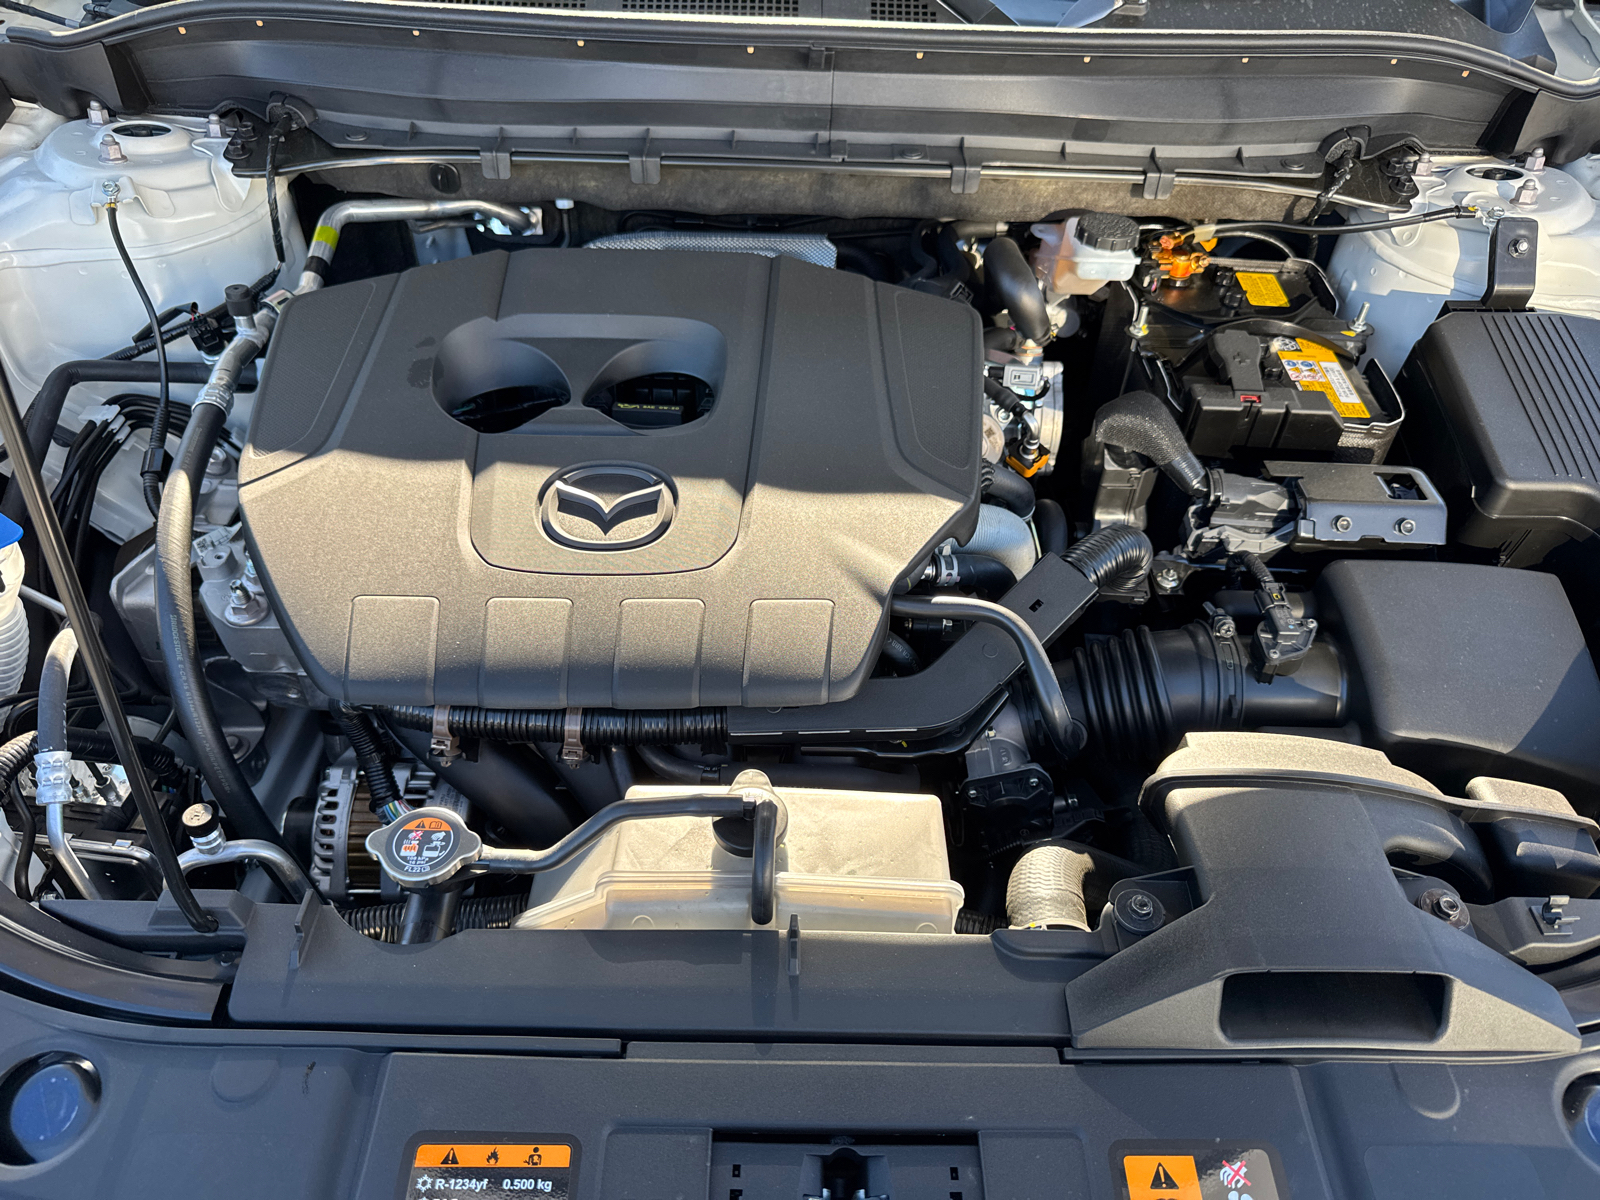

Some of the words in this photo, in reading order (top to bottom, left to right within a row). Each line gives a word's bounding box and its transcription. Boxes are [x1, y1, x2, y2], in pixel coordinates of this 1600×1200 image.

[170, 614, 183, 661] BRIDGESTONE
[435, 1178, 489, 1193] R-1234yf
[502, 1178, 535, 1190] 0.500
[536, 1178, 553, 1193] kg
